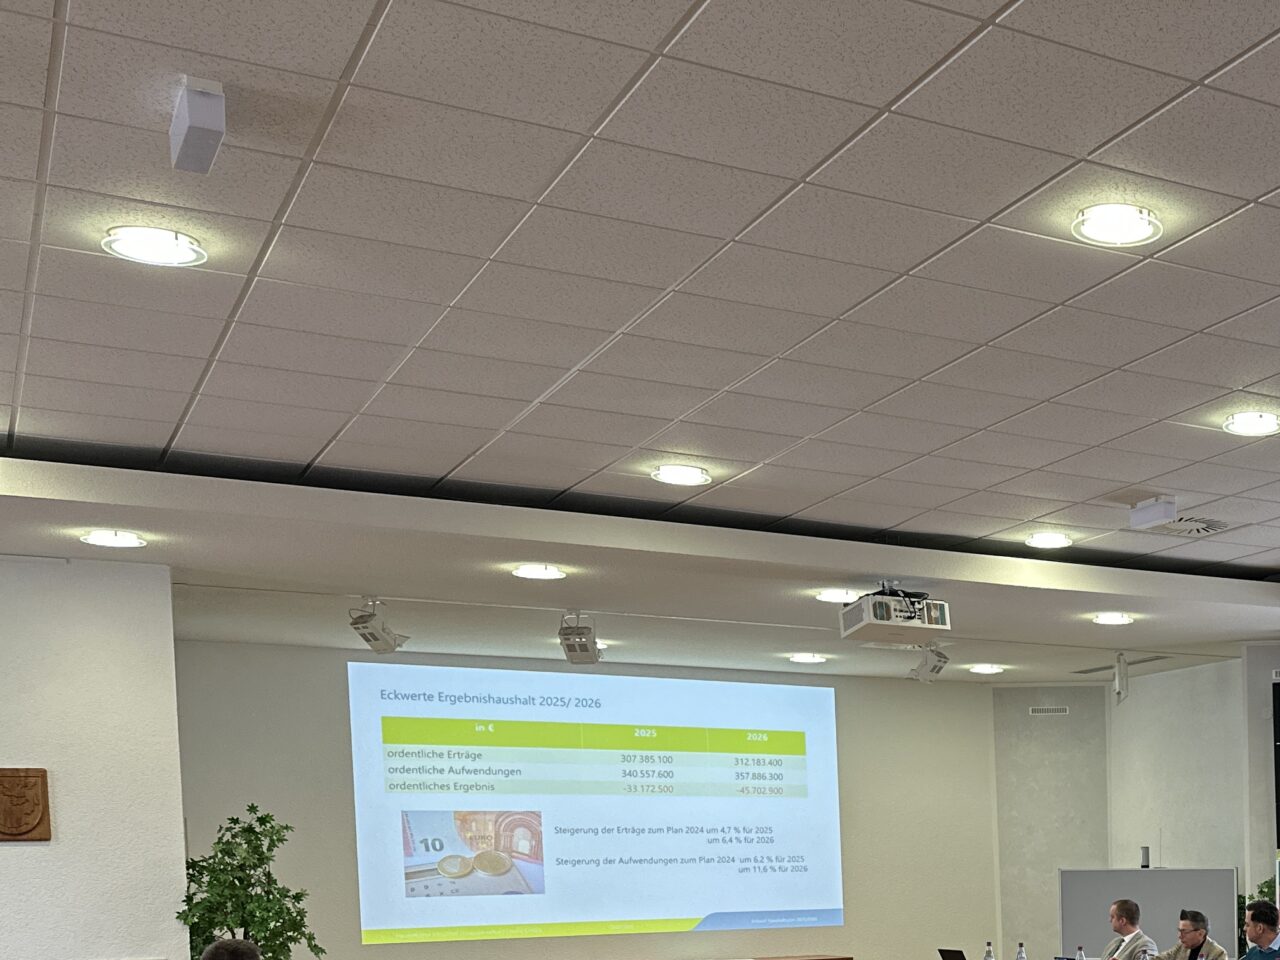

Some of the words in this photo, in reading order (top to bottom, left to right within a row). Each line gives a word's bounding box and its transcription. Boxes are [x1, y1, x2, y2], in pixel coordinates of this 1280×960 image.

[380, 689, 434, 703] Eckwerte
[438, 691, 536, 706] Ergebnishaushalt
[539, 696, 571, 709] 2025/
[574, 698, 602, 710] 2026
[475, 723, 485, 732] in
[487, 723, 495, 732] €
[634, 728, 657, 737] 2025
[746, 732, 768, 742] 2026
[387, 749, 444, 759] ordentliche
[447, 750, 483, 762] Erträge
[621, 754, 673, 764] 307385.100
[388, 764, 445, 775] ordentliche
[448, 765, 522, 778] Aufwendungen
[389, 780, 451, 791] ordentliches
[453, 782, 495, 793] Ergebnis
[554, 826, 599, 836] Steigerung
[601, 826, 614, 834] der
[616, 826, 646, 836] Erträge
[667, 826, 683, 834] Plan
[685, 826, 704, 834] 2024
[734, 826, 741, 834] %
[743, 826, 754, 834] für
[755, 826, 773, 834] 2025
[419, 838, 444, 852] 10
[735, 836, 742, 844] %
[744, 836, 754, 844] für
[756, 836, 775, 844] 2026
[555, 857, 600, 867] Steigerung
[602, 857, 616, 865] der
[618, 857, 679, 867] Aufwendungen
[698, 856, 715, 864] Plan
[717, 856, 736, 864] 2024
[753, 856, 764, 864] 62
[766, 856, 774, 864] %
[775, 855, 785, 863] für
[787, 855, 805, 863] 2025
[769, 865, 777, 873] %
[778, 865, 788, 873] für
[790, 865, 808, 873] 2026
